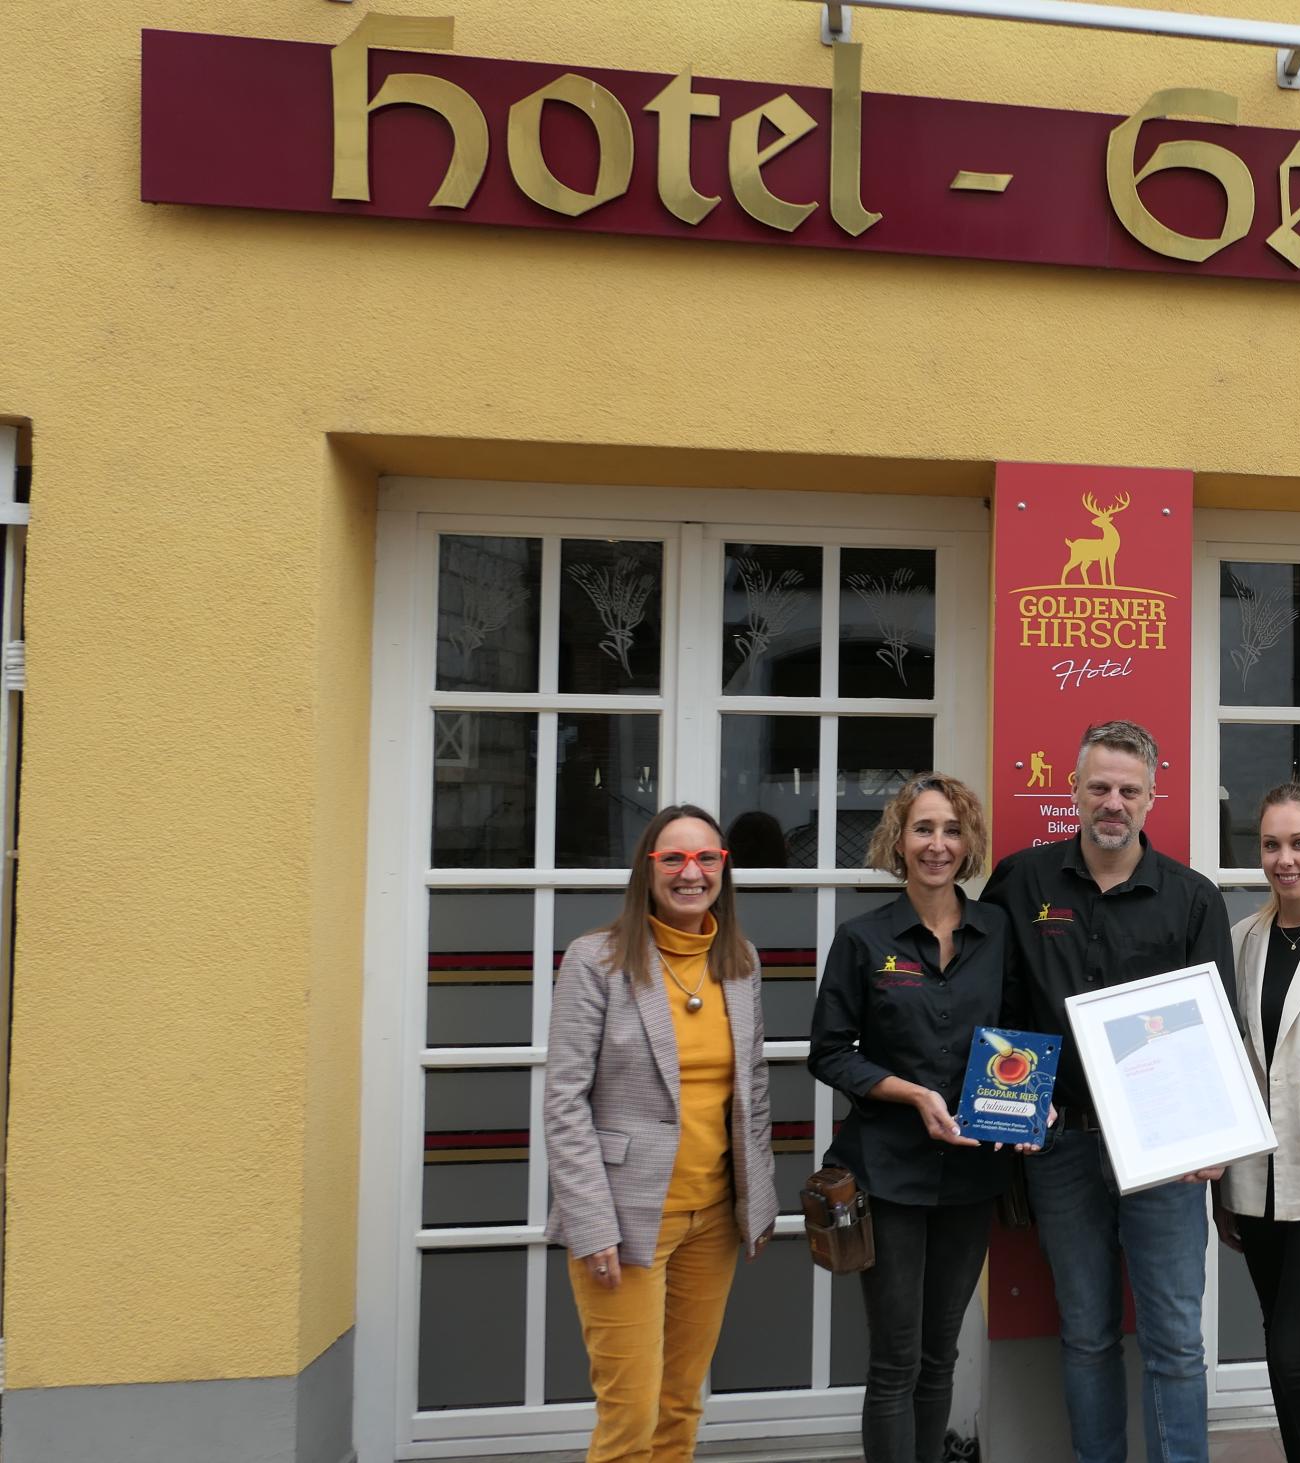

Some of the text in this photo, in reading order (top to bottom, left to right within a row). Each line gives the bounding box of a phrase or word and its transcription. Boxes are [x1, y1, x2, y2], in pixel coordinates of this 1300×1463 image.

[1018, 594, 1167, 621] GOLDENER
[1019, 617, 1167, 650] HIRSCH
[1051, 657, 1133, 691] Hotel
[977, 1088, 1039, 1102] GEOPARK RIES
